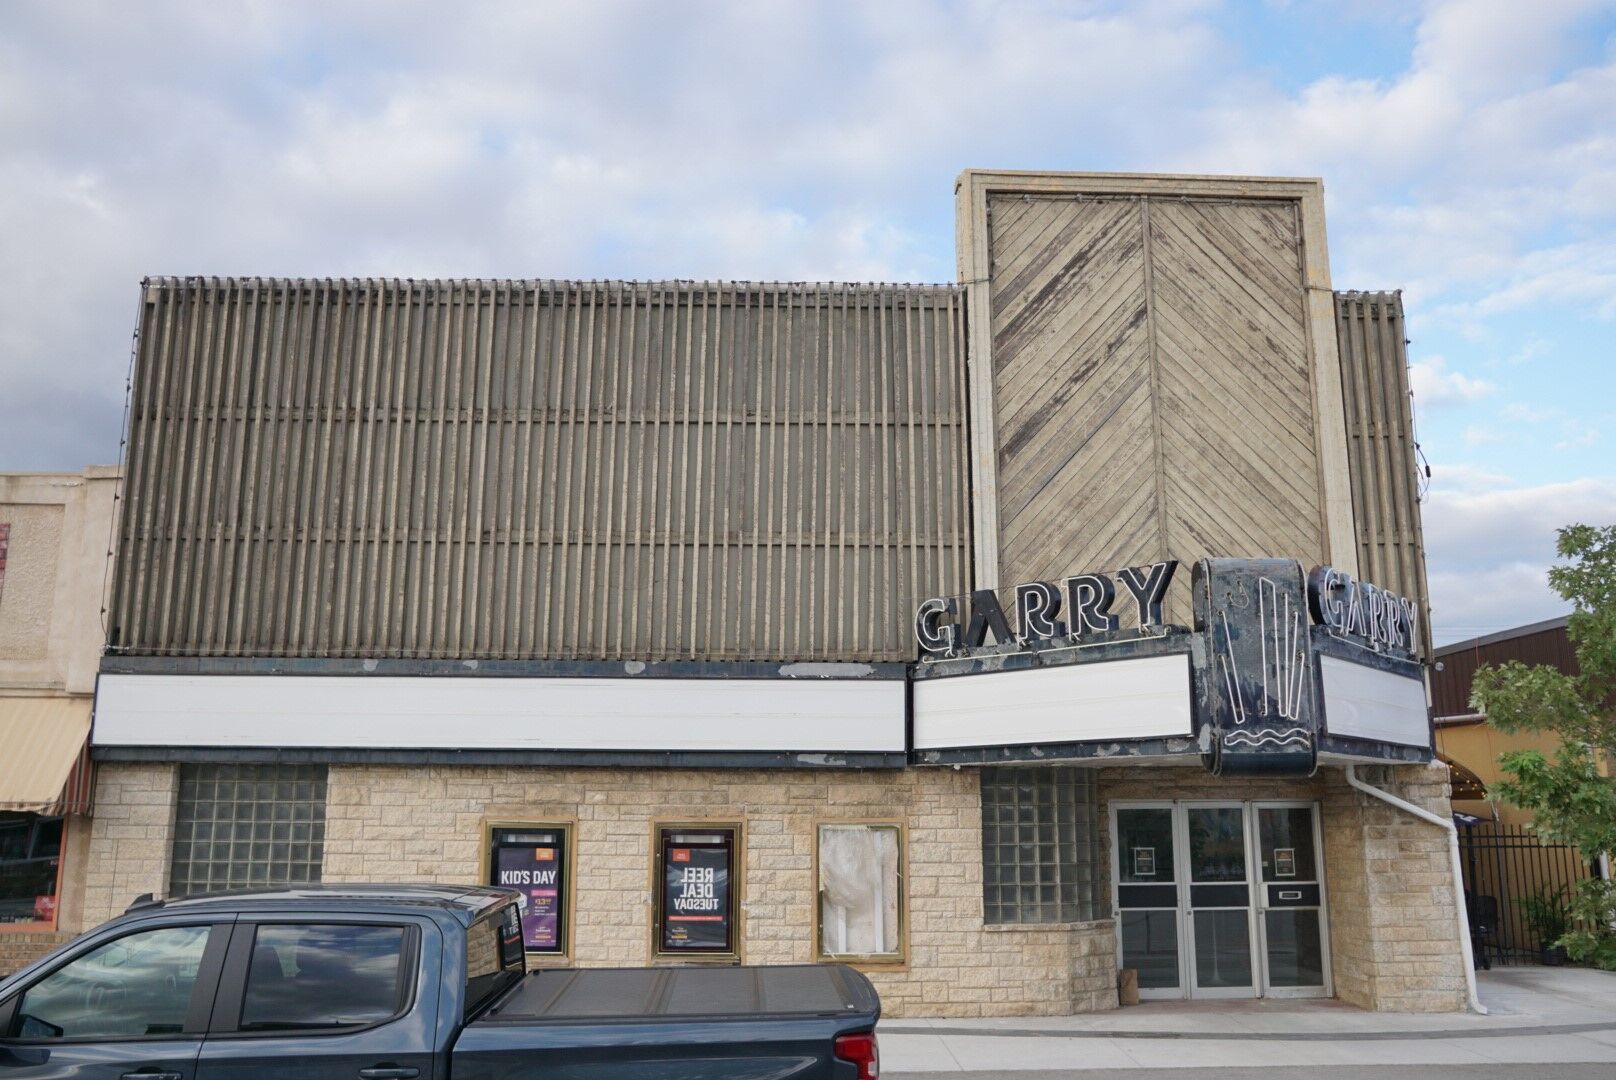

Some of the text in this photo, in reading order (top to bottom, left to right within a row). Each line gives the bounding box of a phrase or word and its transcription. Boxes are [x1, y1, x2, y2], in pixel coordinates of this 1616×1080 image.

[914, 560, 1178, 656] GARRY
[1309, 565, 1418, 654] GARRY
[501, 870, 556, 885] KID'S DAY
